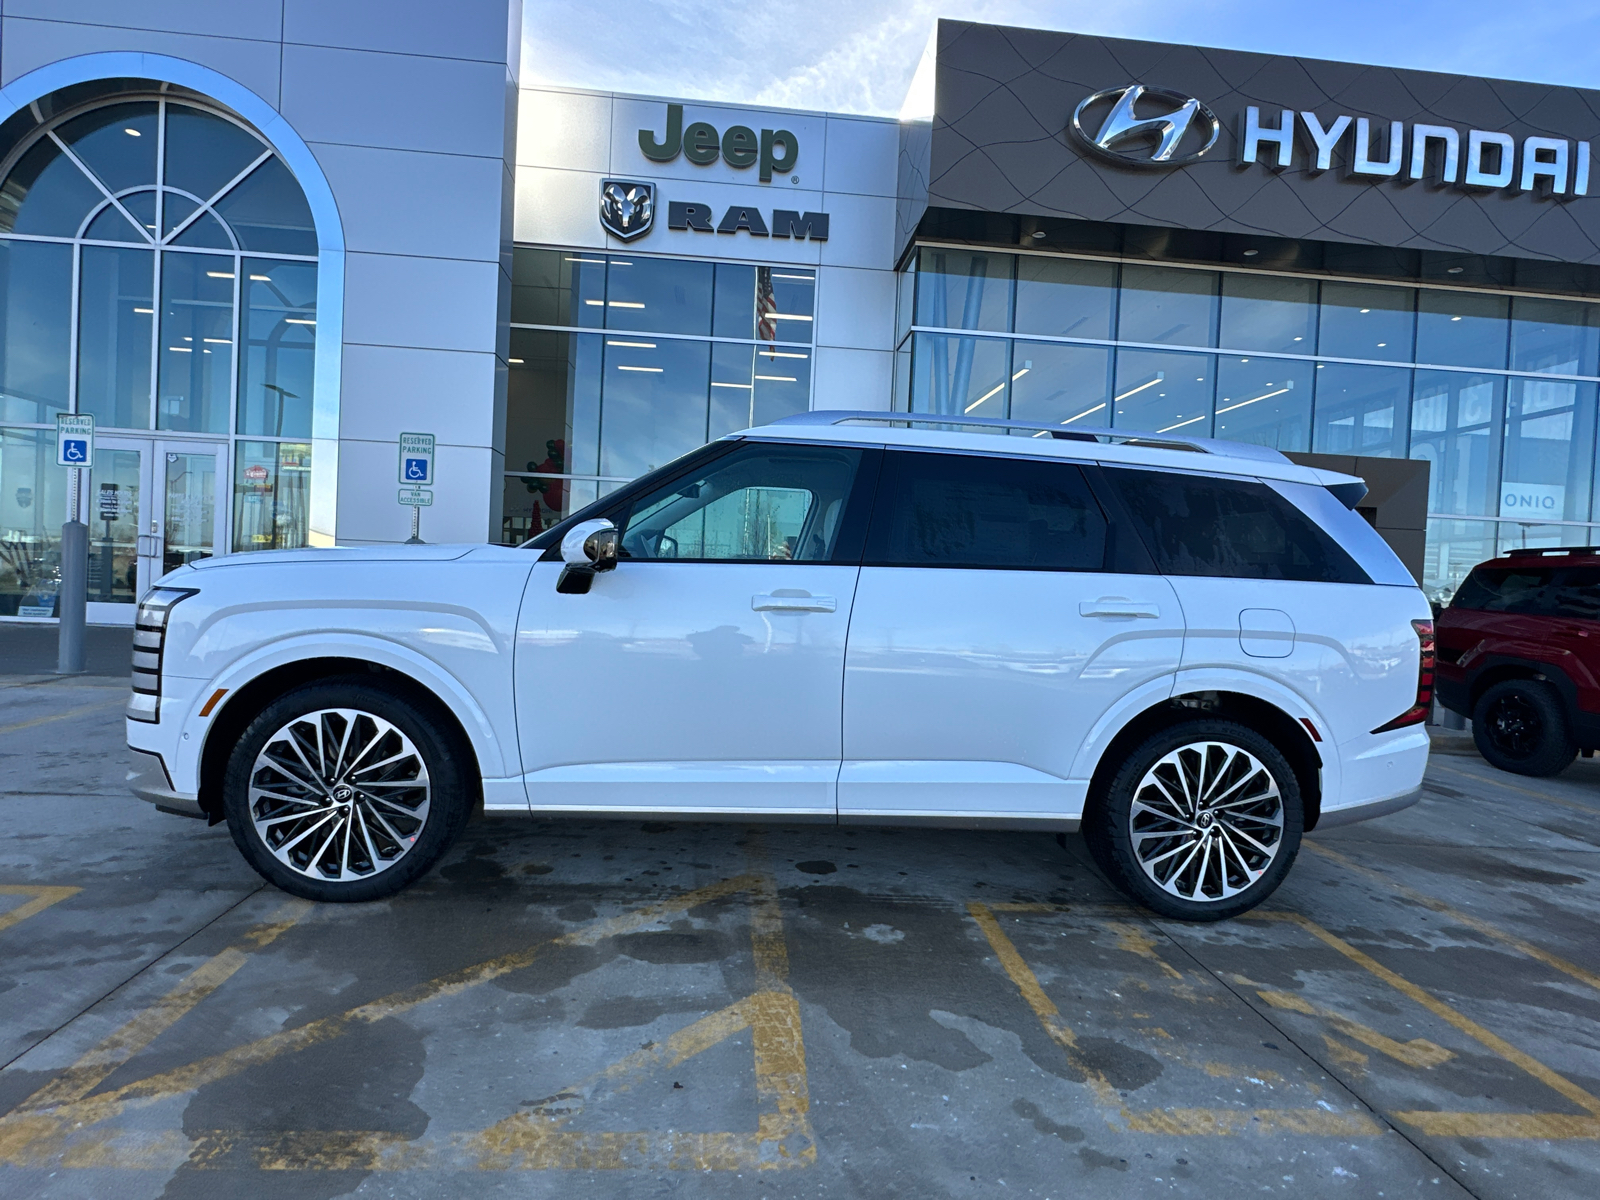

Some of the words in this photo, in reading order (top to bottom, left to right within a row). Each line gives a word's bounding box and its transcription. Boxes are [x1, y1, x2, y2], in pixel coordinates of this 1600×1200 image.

[638, 104, 798, 182] Jeep
[1242, 105, 1591, 196] HYUNDAI
[668, 201, 830, 241] RAM
[60, 417, 91, 426] RESERVED
[60, 427, 92, 435] PARKING
[402, 436, 432, 446] RESERVED
[402, 446, 432, 454] PARKING
